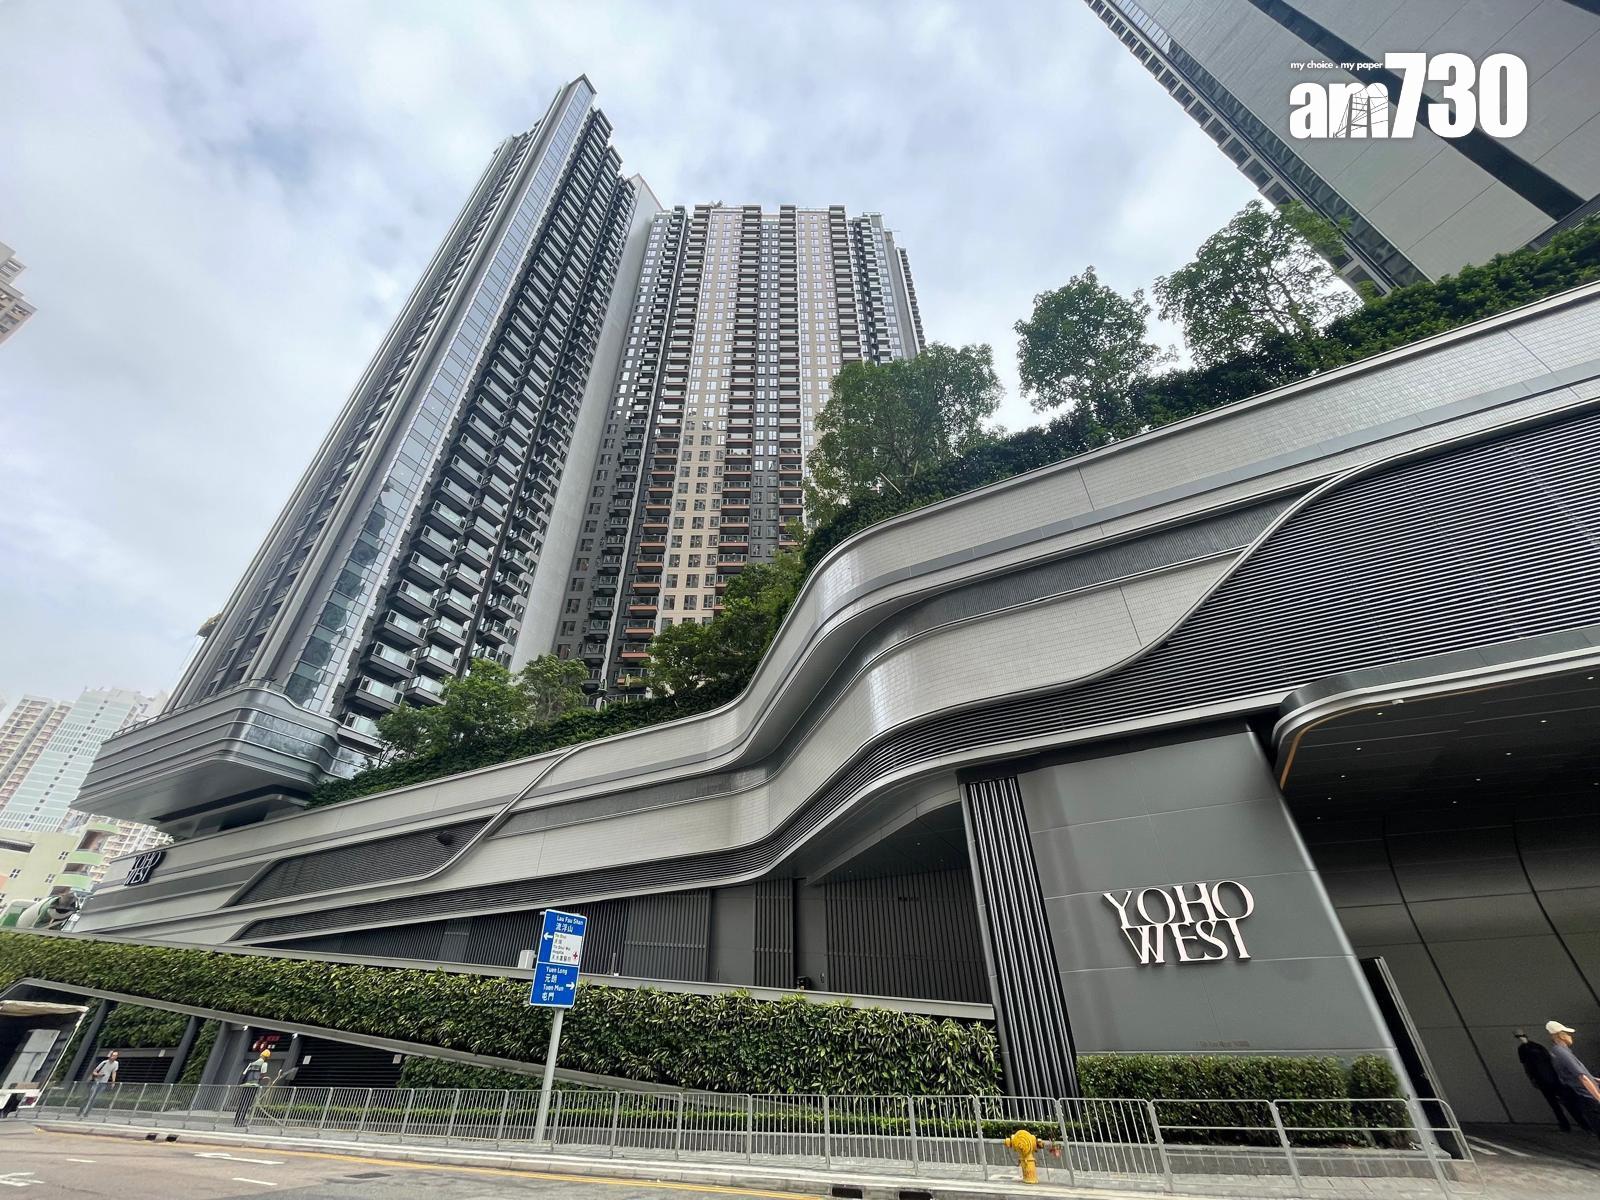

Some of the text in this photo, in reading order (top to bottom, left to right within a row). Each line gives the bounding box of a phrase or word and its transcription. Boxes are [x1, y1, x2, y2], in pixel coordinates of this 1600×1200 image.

[1103, 880, 1255, 929] YOHO
[1121, 918, 1252, 964] WEST
[557, 967, 568, 976] Long
